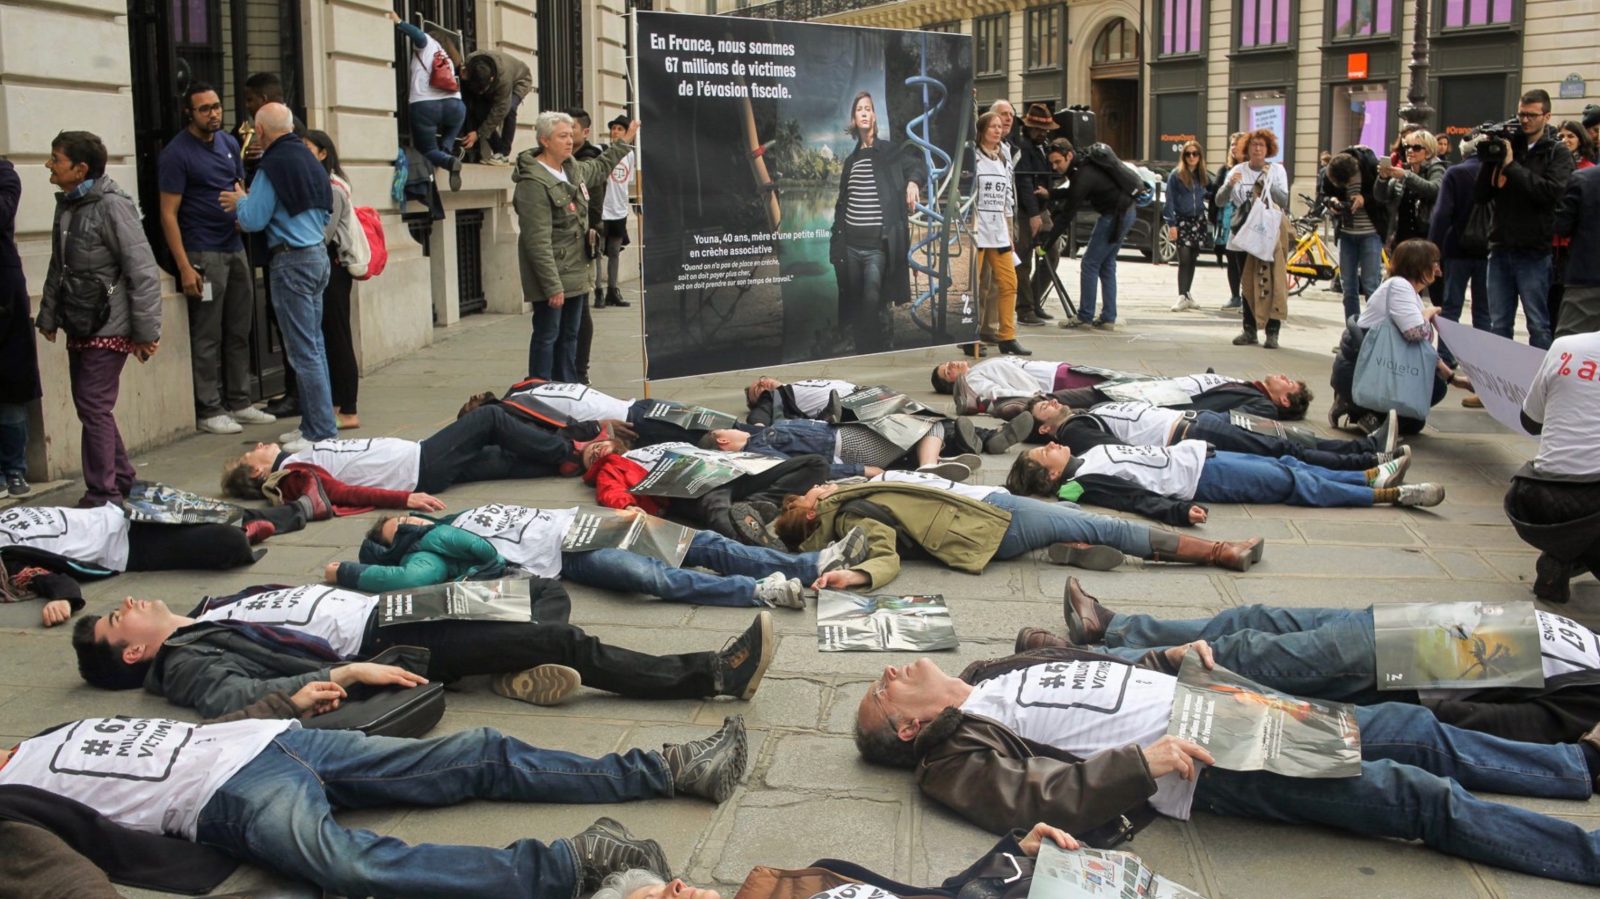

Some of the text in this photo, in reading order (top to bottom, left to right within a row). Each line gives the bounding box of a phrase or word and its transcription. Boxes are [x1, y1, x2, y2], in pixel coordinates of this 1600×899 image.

[650, 33, 795, 56] En France, nous sommes
[665, 57, 796, 77] 67 millions de victimes
[678, 80, 694, 96] de
[751, 83, 792, 99] fiscale.
[995, 182, 1006, 192] 67
[693, 228, 830, 245] Youna, 40 ans, mère d'une petite fille
[690, 245, 772, 258] en crèche associative
[1558, 628, 1586, 653] 67
